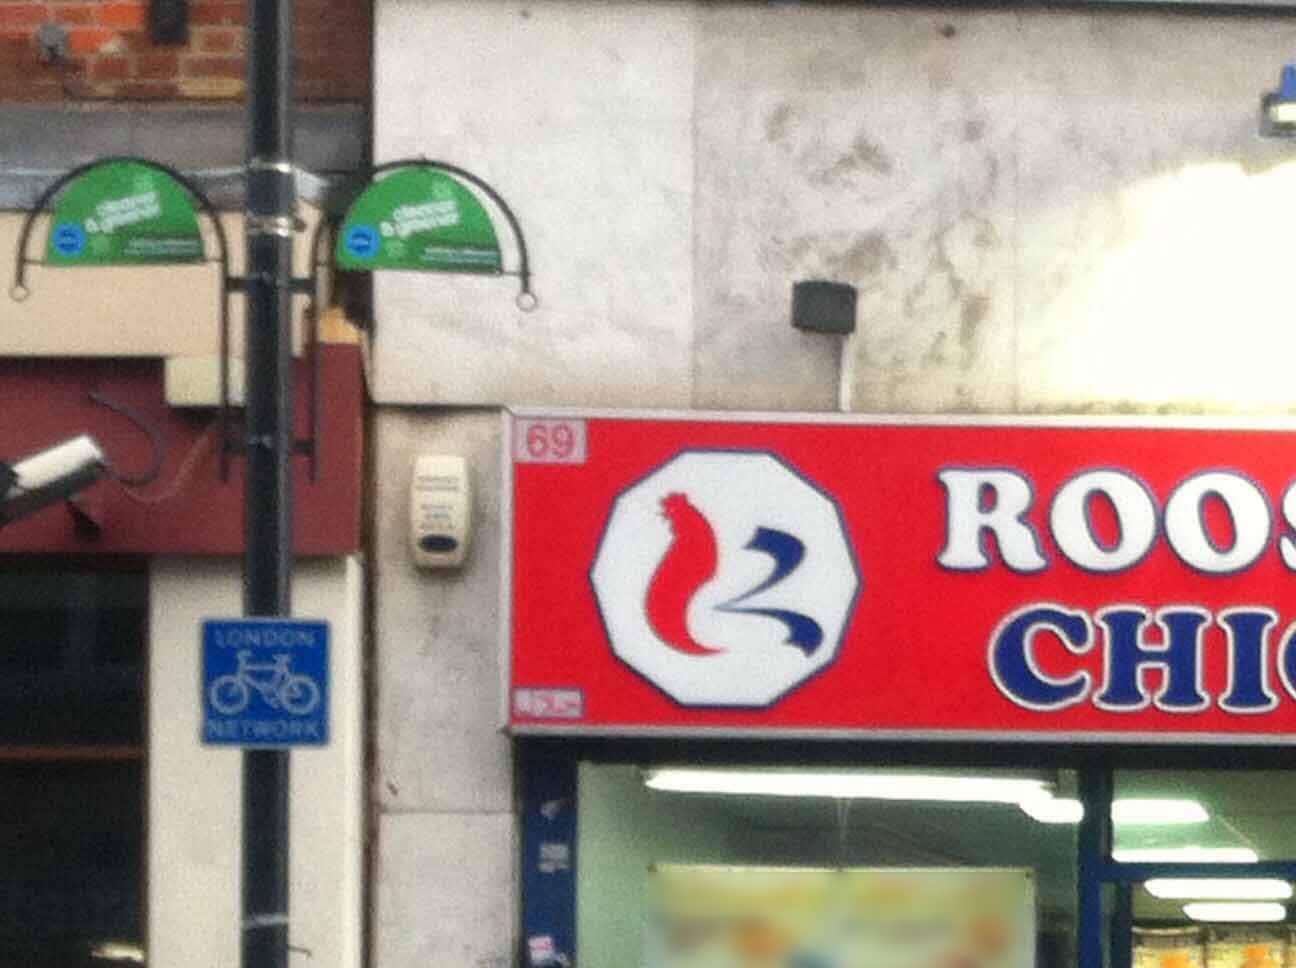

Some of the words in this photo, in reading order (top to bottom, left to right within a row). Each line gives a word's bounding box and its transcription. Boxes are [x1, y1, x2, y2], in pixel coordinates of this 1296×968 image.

[527, 424, 575, 459] 69
[214, 629, 316, 649] LONDON
[207, 719, 321, 738] NETWORK
